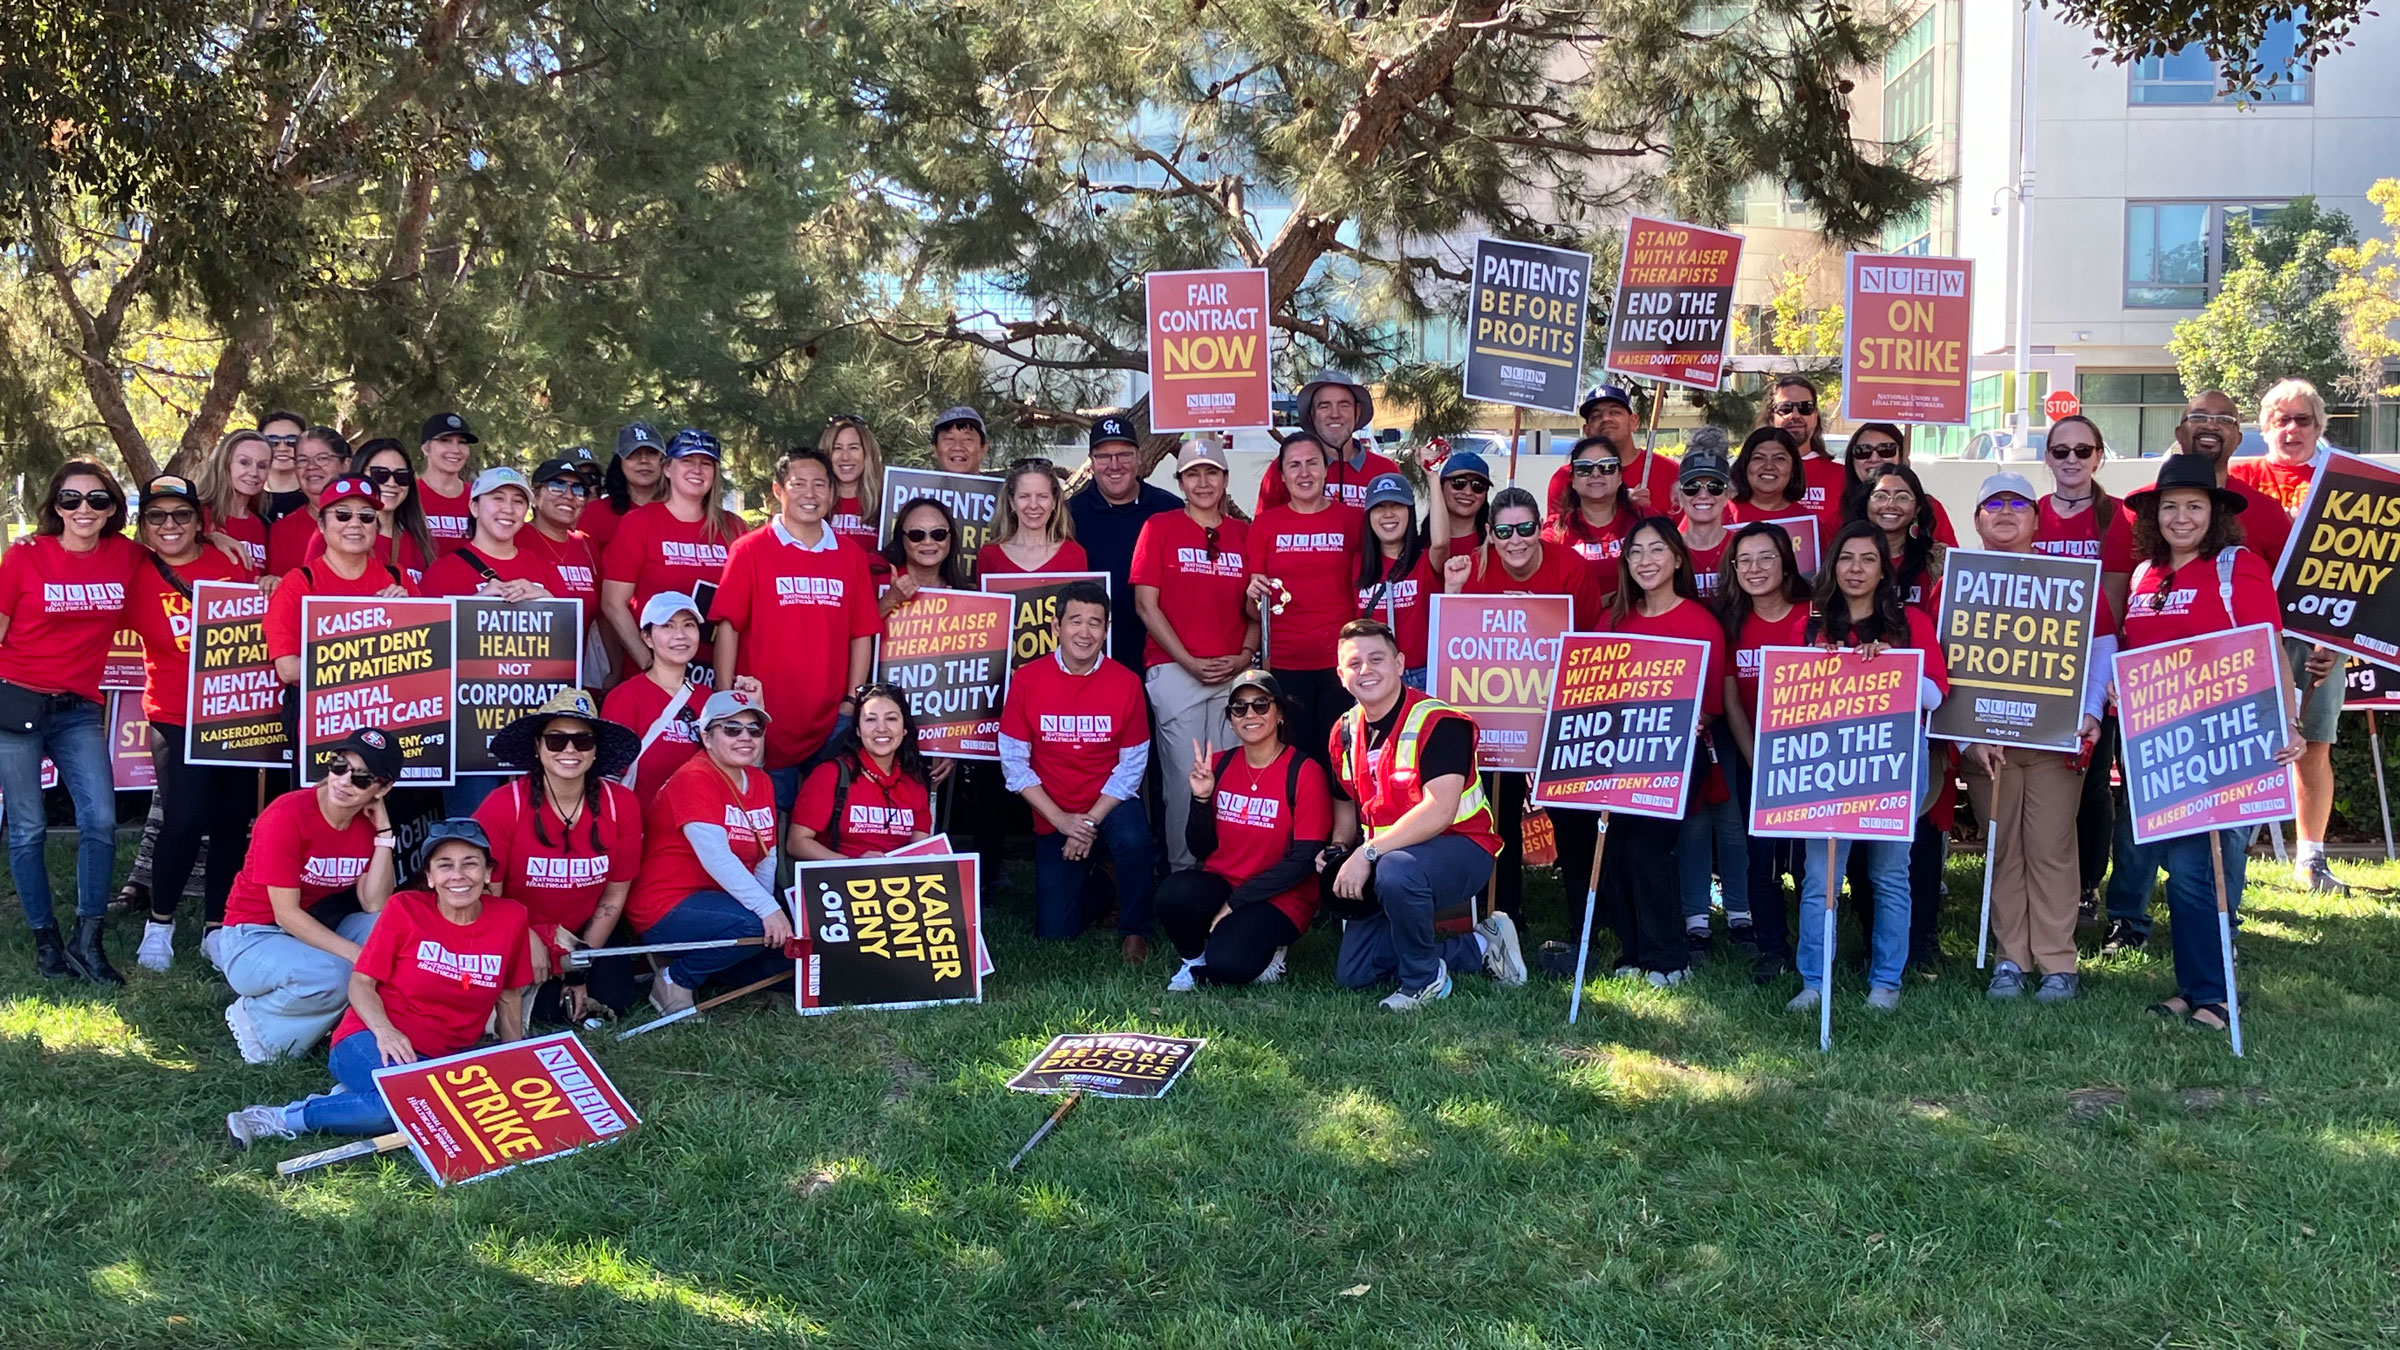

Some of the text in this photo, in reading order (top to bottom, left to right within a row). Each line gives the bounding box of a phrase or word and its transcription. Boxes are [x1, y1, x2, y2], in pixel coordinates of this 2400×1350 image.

[1636, 231, 1688, 247] STAND
[1633, 248, 1729, 265] WITH KAISER
[1482, 255, 1580, 298] PATIENTS
[1629, 267, 1718, 284] THERAPISTS
[1862, 268, 1964, 295] NUHW
[1187, 283, 1228, 306] FAIR
[1480, 289, 1578, 328] BEFORE
[1626, 292, 1717, 315] END THE
[1158, 308, 1259, 333] CONTRACT
[1888, 300, 1935, 333] ON
[1477, 316, 1574, 356] PROFITS
[1620, 318, 1722, 344] INEQUITY
[1163, 335, 1257, 372] NOW
[1616, 353, 1719, 366] KAISERDONTDENY.ORG
[1858, 337, 1961, 373] STRIKE
[1501, 366, 1546, 383] NUHW
[1188, 394, 1234, 407] NUHW
[2047, 399, 2078, 414] STOP
[664, 543, 727, 557] NUHW
[1277, 534, 1344, 547] NUHW
[46, 584, 125, 599] NUHW
[778, 578, 842, 596] NUHW
[1955, 569, 2085, 614] PATIENTS
[2296, 561, 2393, 596] DENY
[316, 607, 393, 636] KAISER,
[477, 610, 554, 633] PATIENT
[890, 597, 948, 618] STAND
[1482, 609, 1527, 633] FAIR
[2287, 594, 2357, 628] .org
[888, 611, 998, 639] WITH KAISER
[1951, 609, 2081, 648] BEFORE
[379, 627, 430, 658] DENY
[479, 635, 550, 657] HEALTH
[886, 632, 988, 658] THERAPISTS
[1448, 637, 1560, 662] CONTRACT
[1568, 642, 1632, 667] STAND
[204, 647, 234, 668] MY
[316, 649, 433, 686] MY PATIENTS
[497, 663, 531, 676] NOT
[1773, 655, 1842, 684] STAND
[1947, 643, 2077, 682] PROFITS
[2128, 647, 2194, 688] STAND
[203, 669, 279, 696] MENTAL
[887, 658, 991, 690] END THE
[1450, 666, 1557, 705] NOW
[1564, 658, 1687, 687] WITH KAISER
[2129, 647, 2255, 710] WITH KAISER
[316, 684, 394, 716] MENTAL
[1560, 679, 1674, 707] THERAPISTS
[1772, 670, 1902, 706] WITH KAISER
[202, 690, 274, 717] HEALTH
[315, 697, 443, 737] HEALTH CARE
[1770, 693, 1890, 728] THERAPISTS
[1976, 699, 2036, 718] NUHW
[2131, 674, 2249, 732] THERAPISTS
[1042, 716, 1111, 731] NUHW
[1558, 706, 1674, 741] END THE
[2139, 702, 2258, 769] END THE
[960, 740, 997, 751] NUHW
[1551, 735, 1683, 771] INEQUITY
[1771, 721, 1893, 765] END THE
[401, 767, 442, 778] NUHW
[1767, 752, 1907, 797] INEQUITY
[2142, 730, 2275, 802] INEQUITY
[1546, 775, 1679, 798] KAISERDONTDENY.ORG
[1631, 793, 1673, 808] NUHW
[1217, 791, 1278, 817] NUHW
[1765, 796, 1908, 826] KAISERDONTDENY.ORG
[2147, 773, 2286, 831] KAISERDONTDENY.ORG
[2239, 799, 2286, 815] NUHW
[1859, 818, 1904, 830] NUHW
[528, 856, 609, 876] NUHW
[819, 881, 850, 943] .org
[846, 878, 891, 959] DENY
[881, 876, 926, 962] DONT
[914, 873, 962, 983] KAISER
[418, 941, 501, 974] NUHW
[809, 954, 820, 996] NUHW
[1050, 1048, 1179, 1066] BEFORE
[1060, 1037, 1188, 1055] PATIENTS
[1039, 1059, 1170, 1075] PROFITS
[511, 1077, 571, 1122] ON
[535, 1046, 626, 1135] NUHW
[445, 1064, 543, 1159] STRIKE
